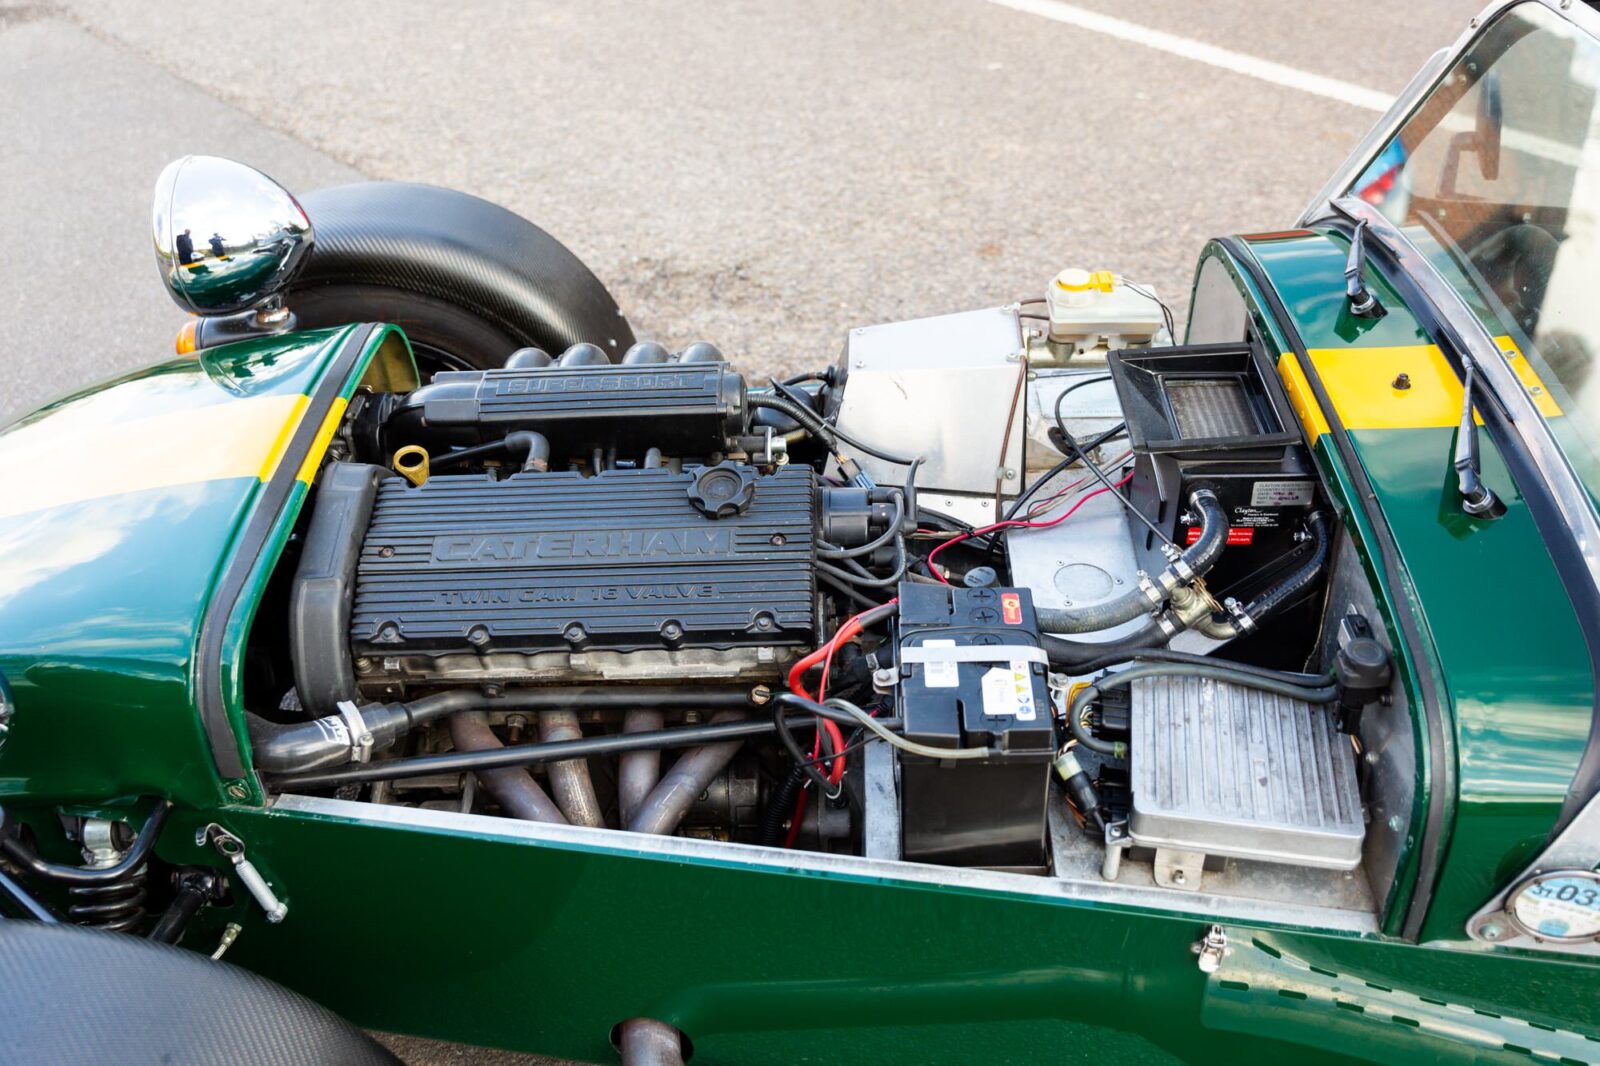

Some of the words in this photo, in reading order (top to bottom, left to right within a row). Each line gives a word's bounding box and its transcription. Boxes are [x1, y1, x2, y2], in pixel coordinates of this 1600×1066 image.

[507, 373, 697, 394] SUPERSPORT
[434, 528, 731, 561] CATERHAM
[440, 590, 511, 605] TWIN
[519, 588, 576, 603] CAM
[591, 587, 618, 601] 16
[625, 584, 714, 600] VALVE
[1555, 884, 1598, 906] 03
